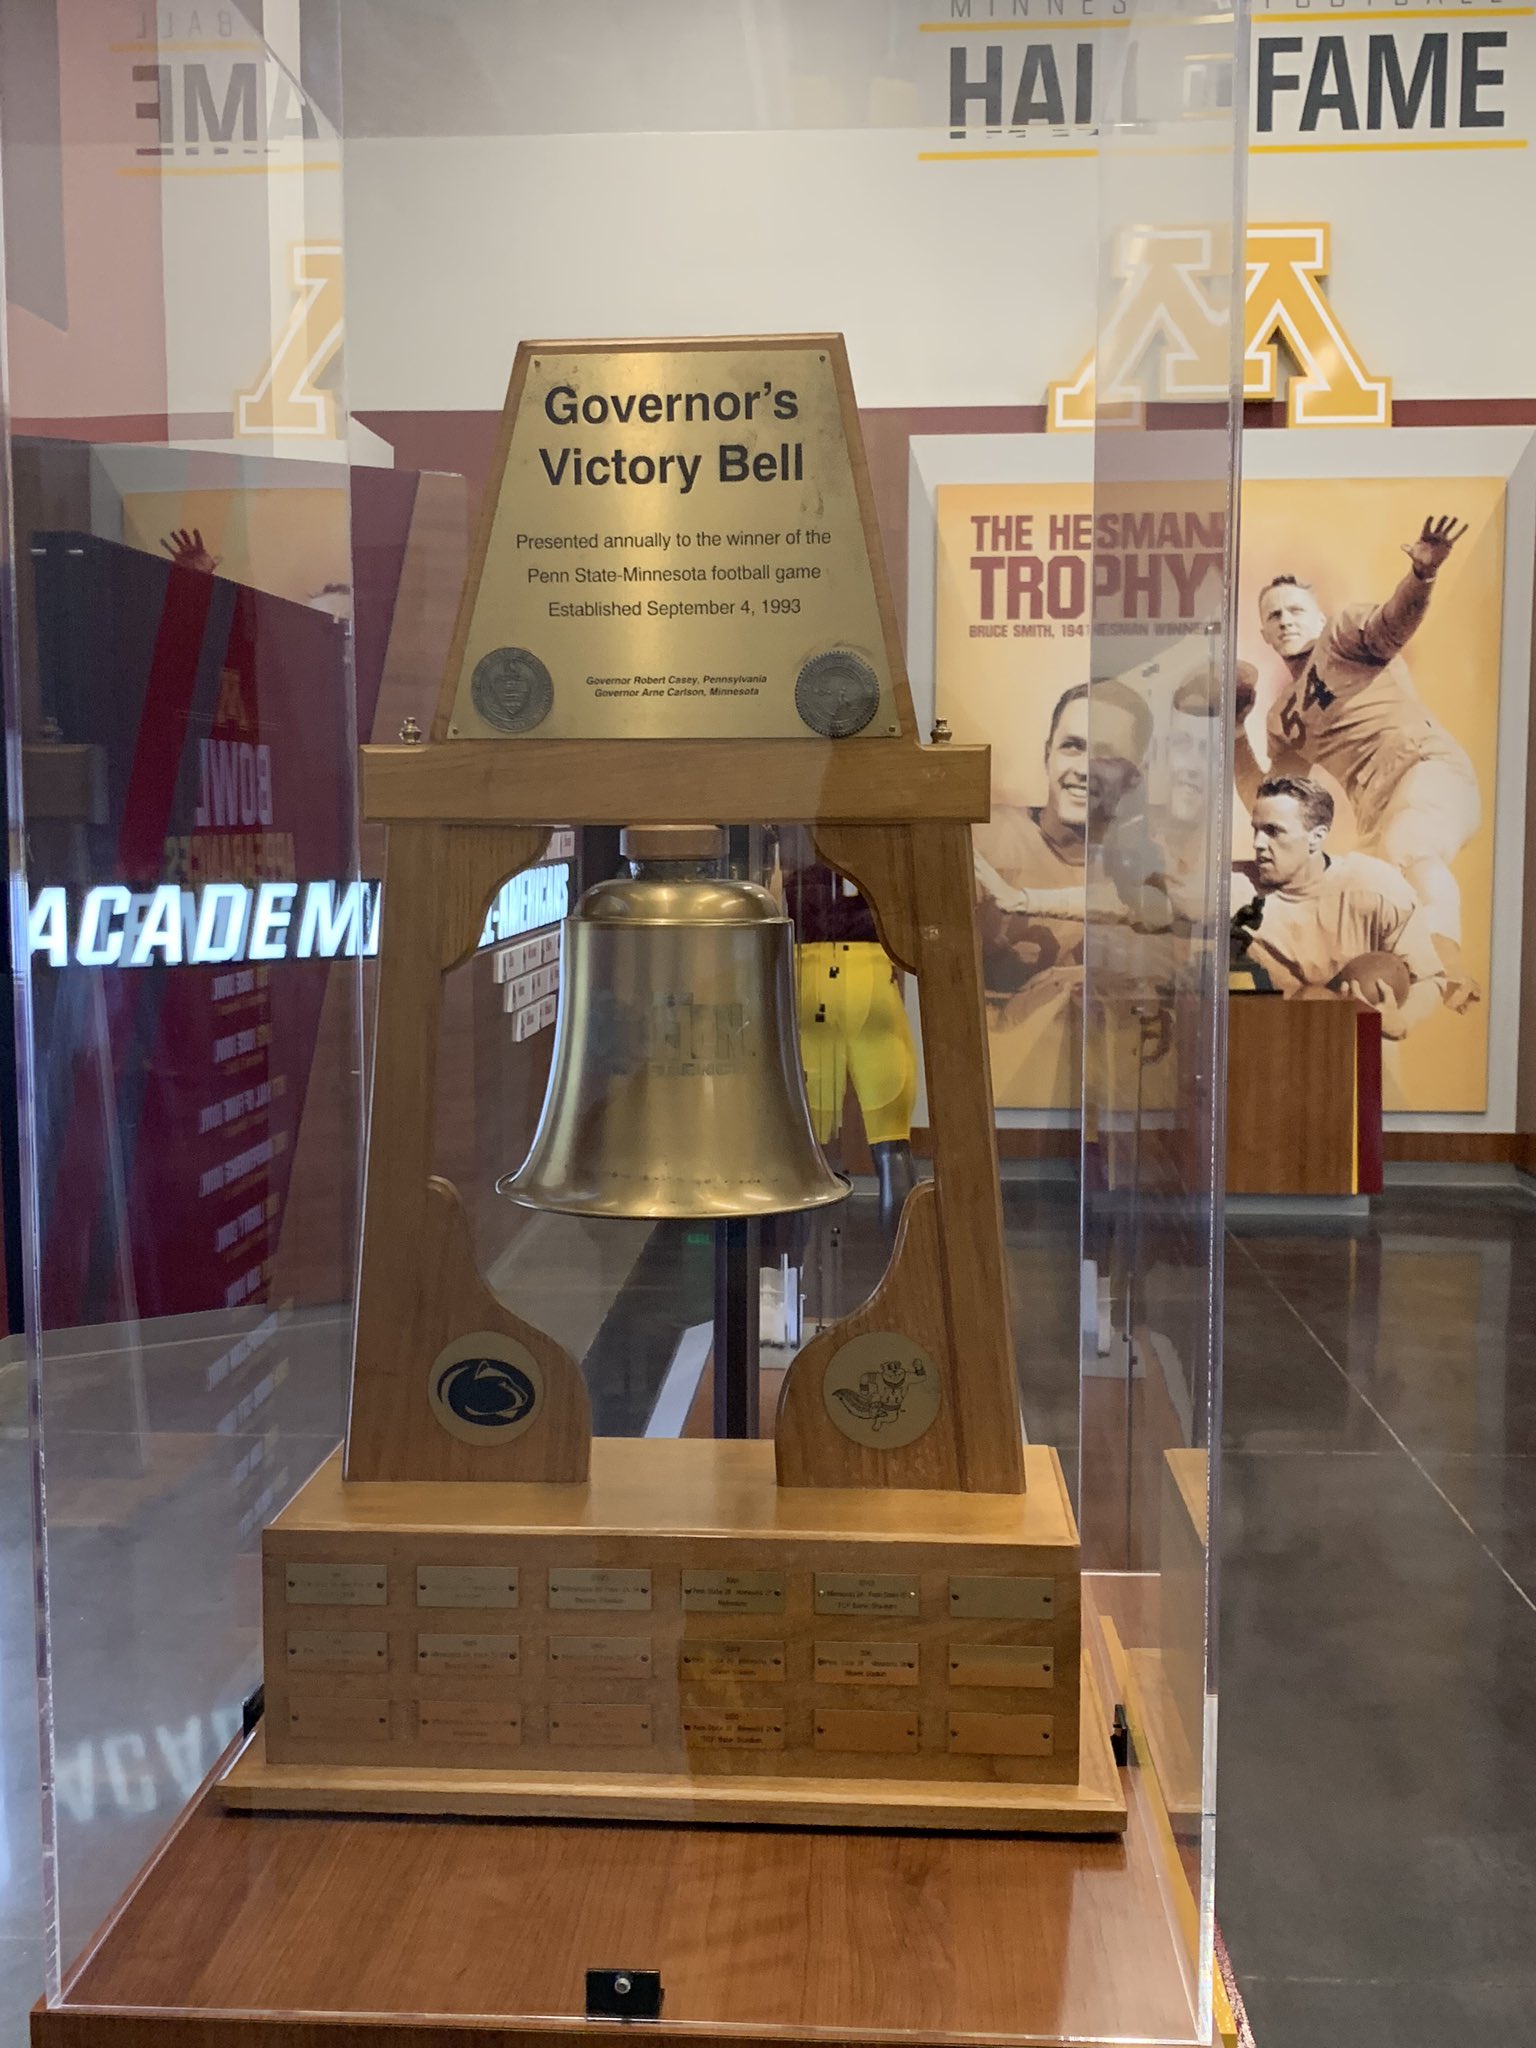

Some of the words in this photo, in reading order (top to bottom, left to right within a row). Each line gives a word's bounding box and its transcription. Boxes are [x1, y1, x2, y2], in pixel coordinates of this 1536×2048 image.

[1256, 31, 1508, 132] FAME
[544, 381, 799, 425] Governor's
[538, 448, 702, 494] Victory
[719, 443, 803, 482] Bell
[516, 534, 598, 549] Presented
[603, 532, 671, 551] annually
[676, 532, 691, 547] to
[696, 531, 721, 546] the
[726, 530, 780, 545] winner
[785, 529, 801, 544] of
[805, 529, 831, 544] the
[970, 514, 1033, 551] THE
[1049, 511, 1225, 551] HESMAN
[528, 568, 569, 583] Penn
[575, 566, 707, 583] State-Minnesota
[712, 565, 770, 580] football
[775, 566, 821, 582] game
[970, 552, 1225, 620] TROPHY
[549, 601, 641, 617] Established
[647, 600, 735, 618] September
[740, 600, 755, 615] 4,
[762, 598, 801, 613] 1993
[969, 625, 1008, 638] BRUCE
[1013, 624, 1055, 640] SMITH,
[586, 676, 631, 685] Governor
[633, 676, 666, 685] Robert
[668, 675, 699, 686] Casey,
[703, 674, 767, 684] Pennsylvania
[594, 689, 639, 697] Governor
[641, 688, 665, 697] Arne
[667, 688, 707, 697] Carlson,
[709, 687, 760, 696] Minnesota
